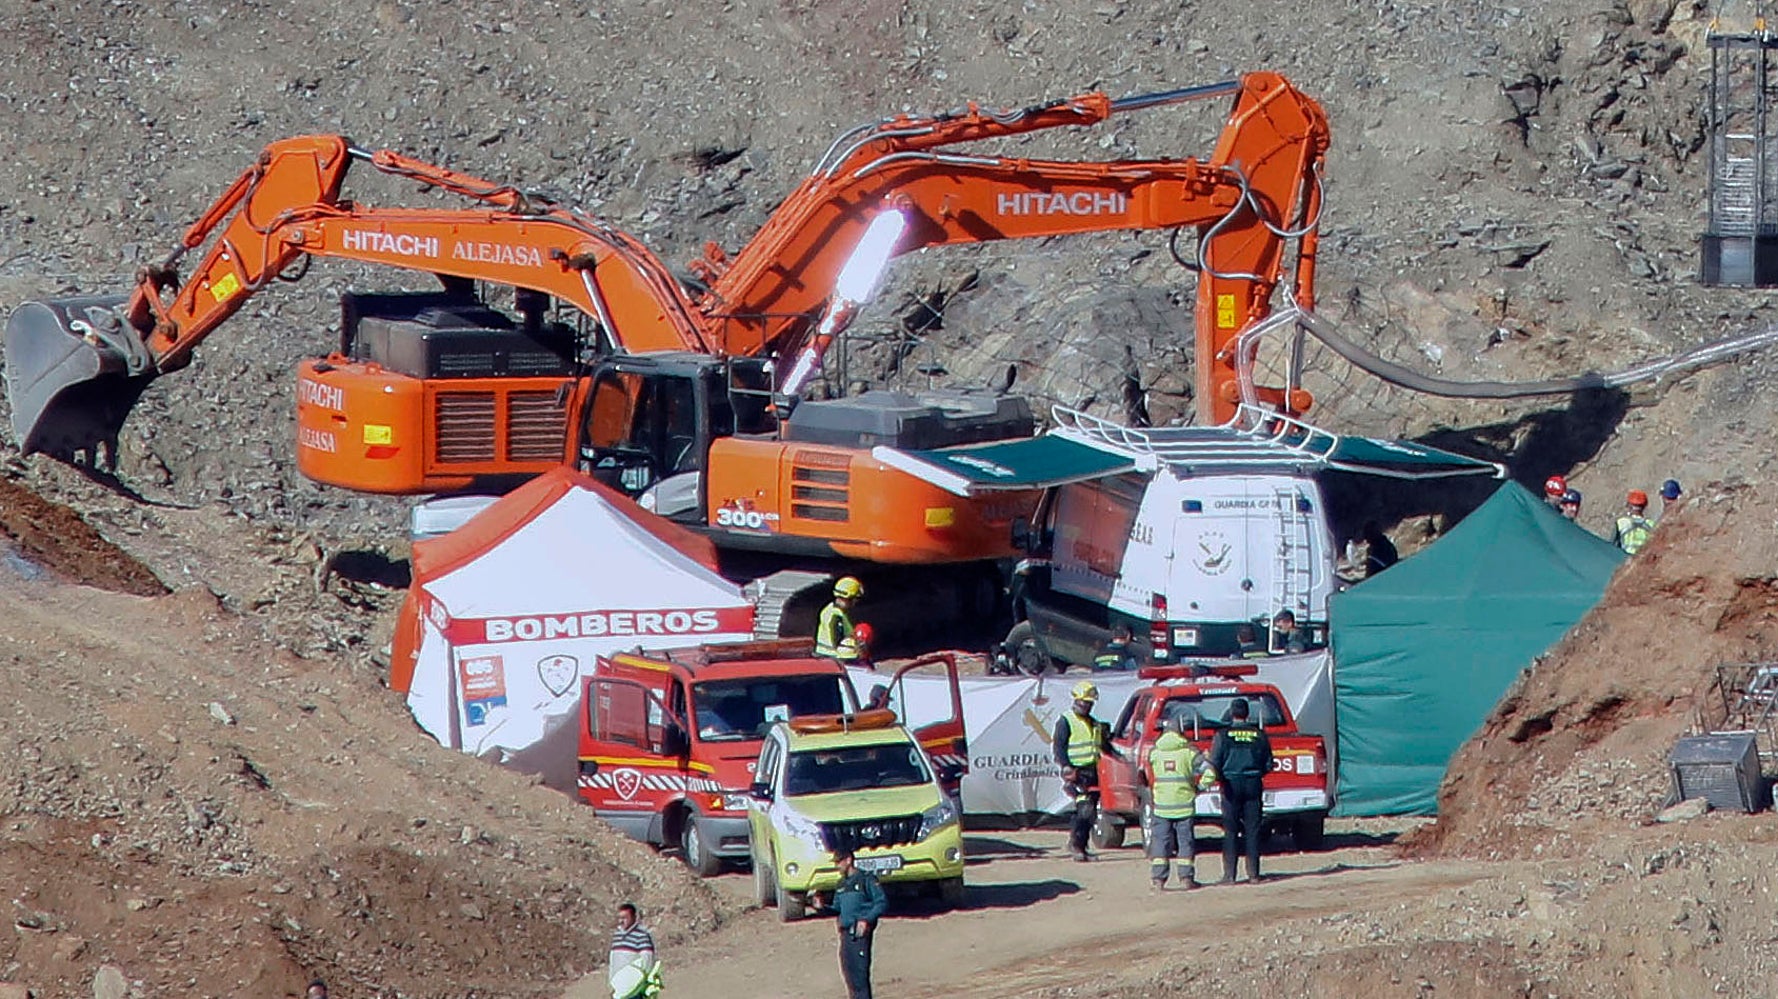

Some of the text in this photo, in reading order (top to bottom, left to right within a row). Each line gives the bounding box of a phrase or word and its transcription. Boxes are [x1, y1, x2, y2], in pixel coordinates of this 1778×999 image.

[997, 192, 1126, 215] HITACHI
[342, 229, 543, 267] HITACHI ALEJASA
[717, 508, 761, 528] 300
[485, 611, 719, 641] BOMBEROS
[974, 753, 1051, 769] GUARDIA
